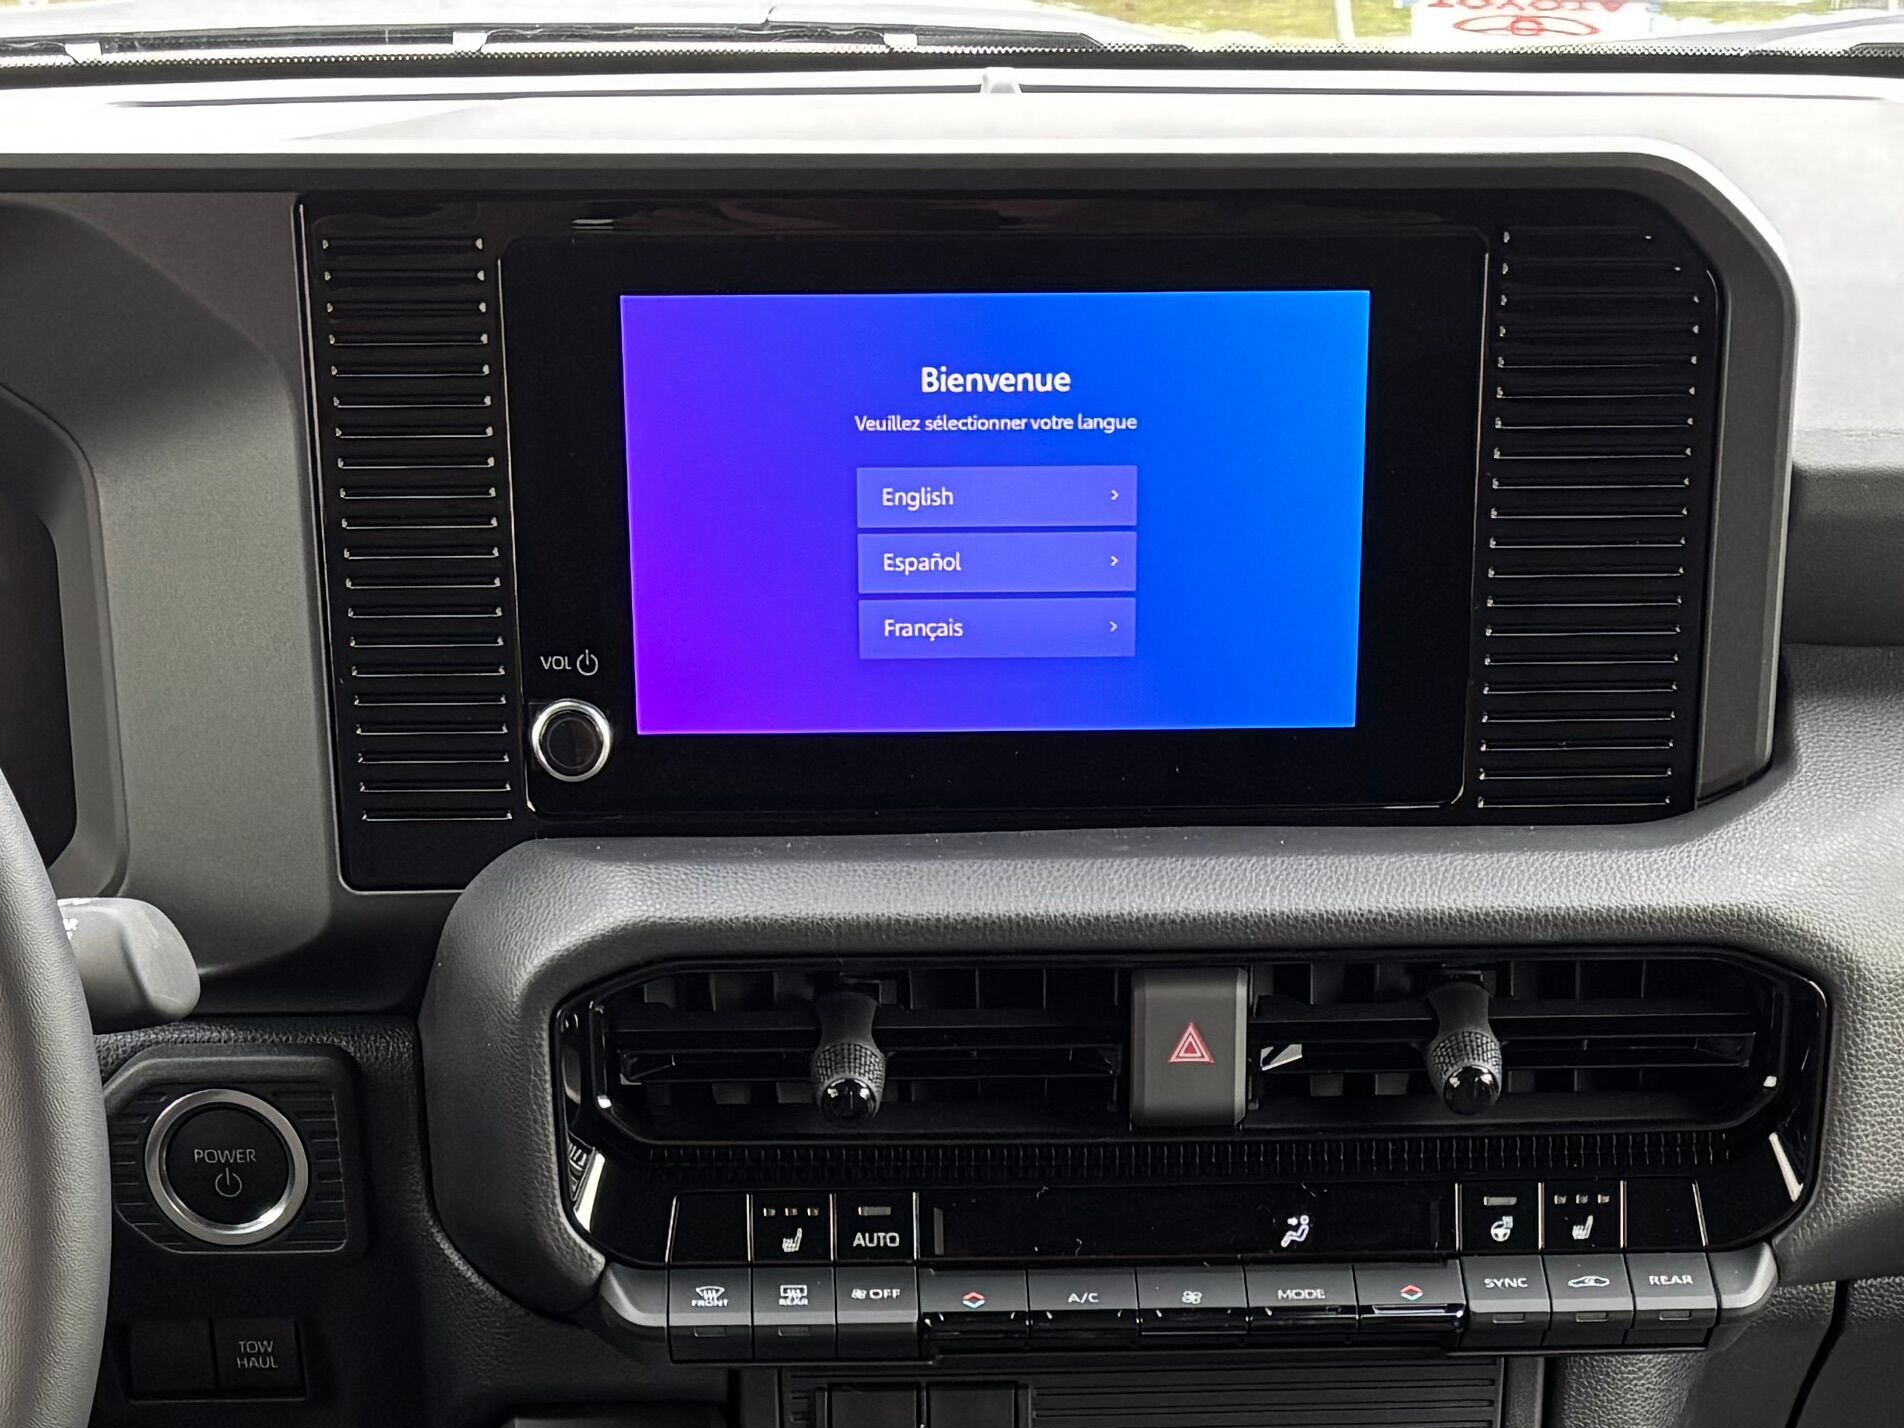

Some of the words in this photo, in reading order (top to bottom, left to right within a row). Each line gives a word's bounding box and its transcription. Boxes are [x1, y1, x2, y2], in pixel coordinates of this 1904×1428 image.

[921, 366, 1072, 394] Bienvenue
[855, 415, 921, 432] Veuillez
[924, 413, 1027, 432] sélectionner
[1030, 416, 1074, 431] votre
[1077, 413, 1138, 434] langue
[881, 486, 954, 511] English
[882, 551, 962, 575] Español
[883, 616, 964, 645] Français
[540, 656, 572, 670] VOL
[192, 1147, 258, 1165] POWER
[852, 1231, 901, 1248] AUTO
[1483, 1276, 1529, 1289] SYNC
[1648, 1273, 1694, 1286] REAR
[868, 1288, 901, 1300] OFF
[1067, 1291, 1100, 1304] A/C
[1277, 1288, 1326, 1301] MODE
[691, 1299, 729, 1308] FRONT
[238, 1340, 274, 1354] TOW
[236, 1354, 279, 1371] HAUL
